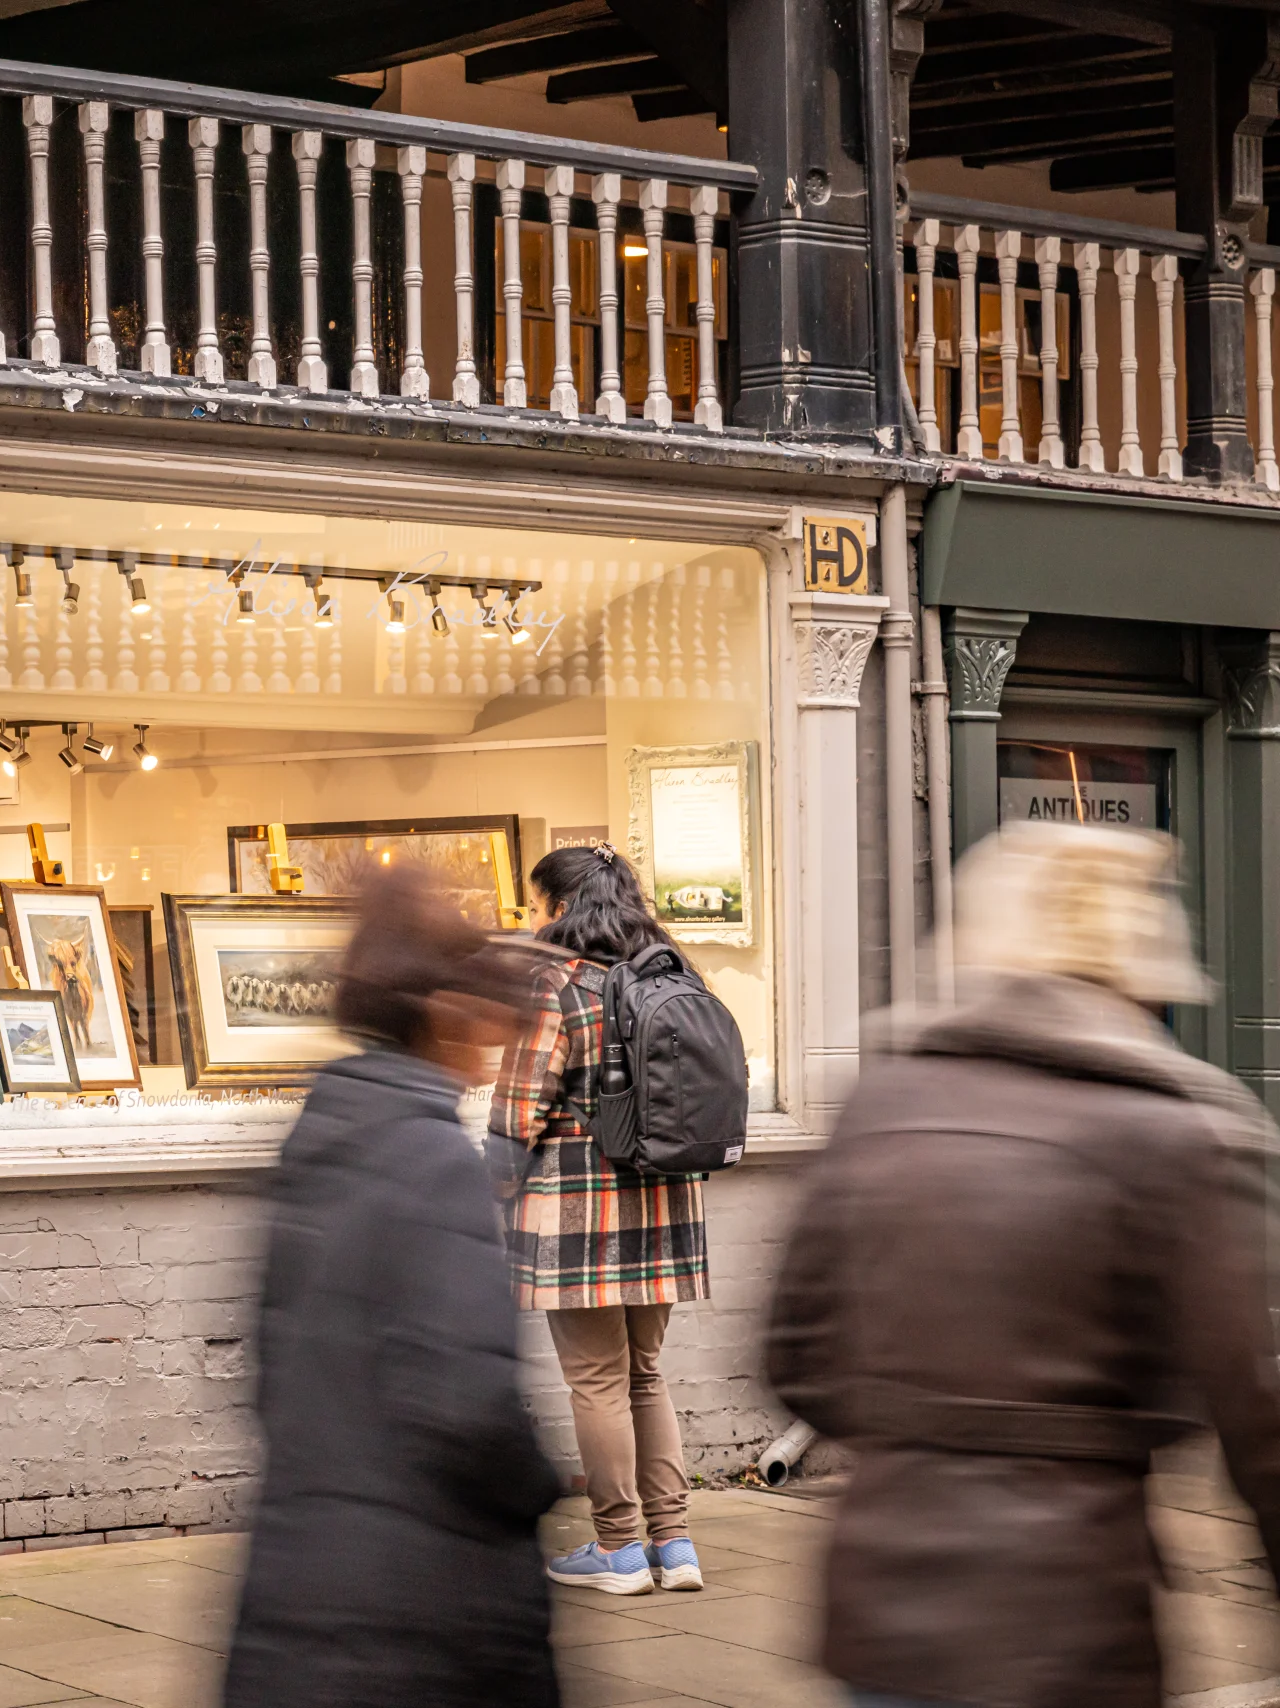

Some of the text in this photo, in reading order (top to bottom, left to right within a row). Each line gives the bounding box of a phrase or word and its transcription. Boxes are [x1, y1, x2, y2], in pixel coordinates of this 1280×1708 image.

[1028, 797, 1130, 823] ANTIQUES
[107, 1091, 125, 1114] of
[126, 1090, 214, 1110] Snowdonia,
[220, 1088, 263, 1106] North
[267, 1088, 308, 1105] Wale
